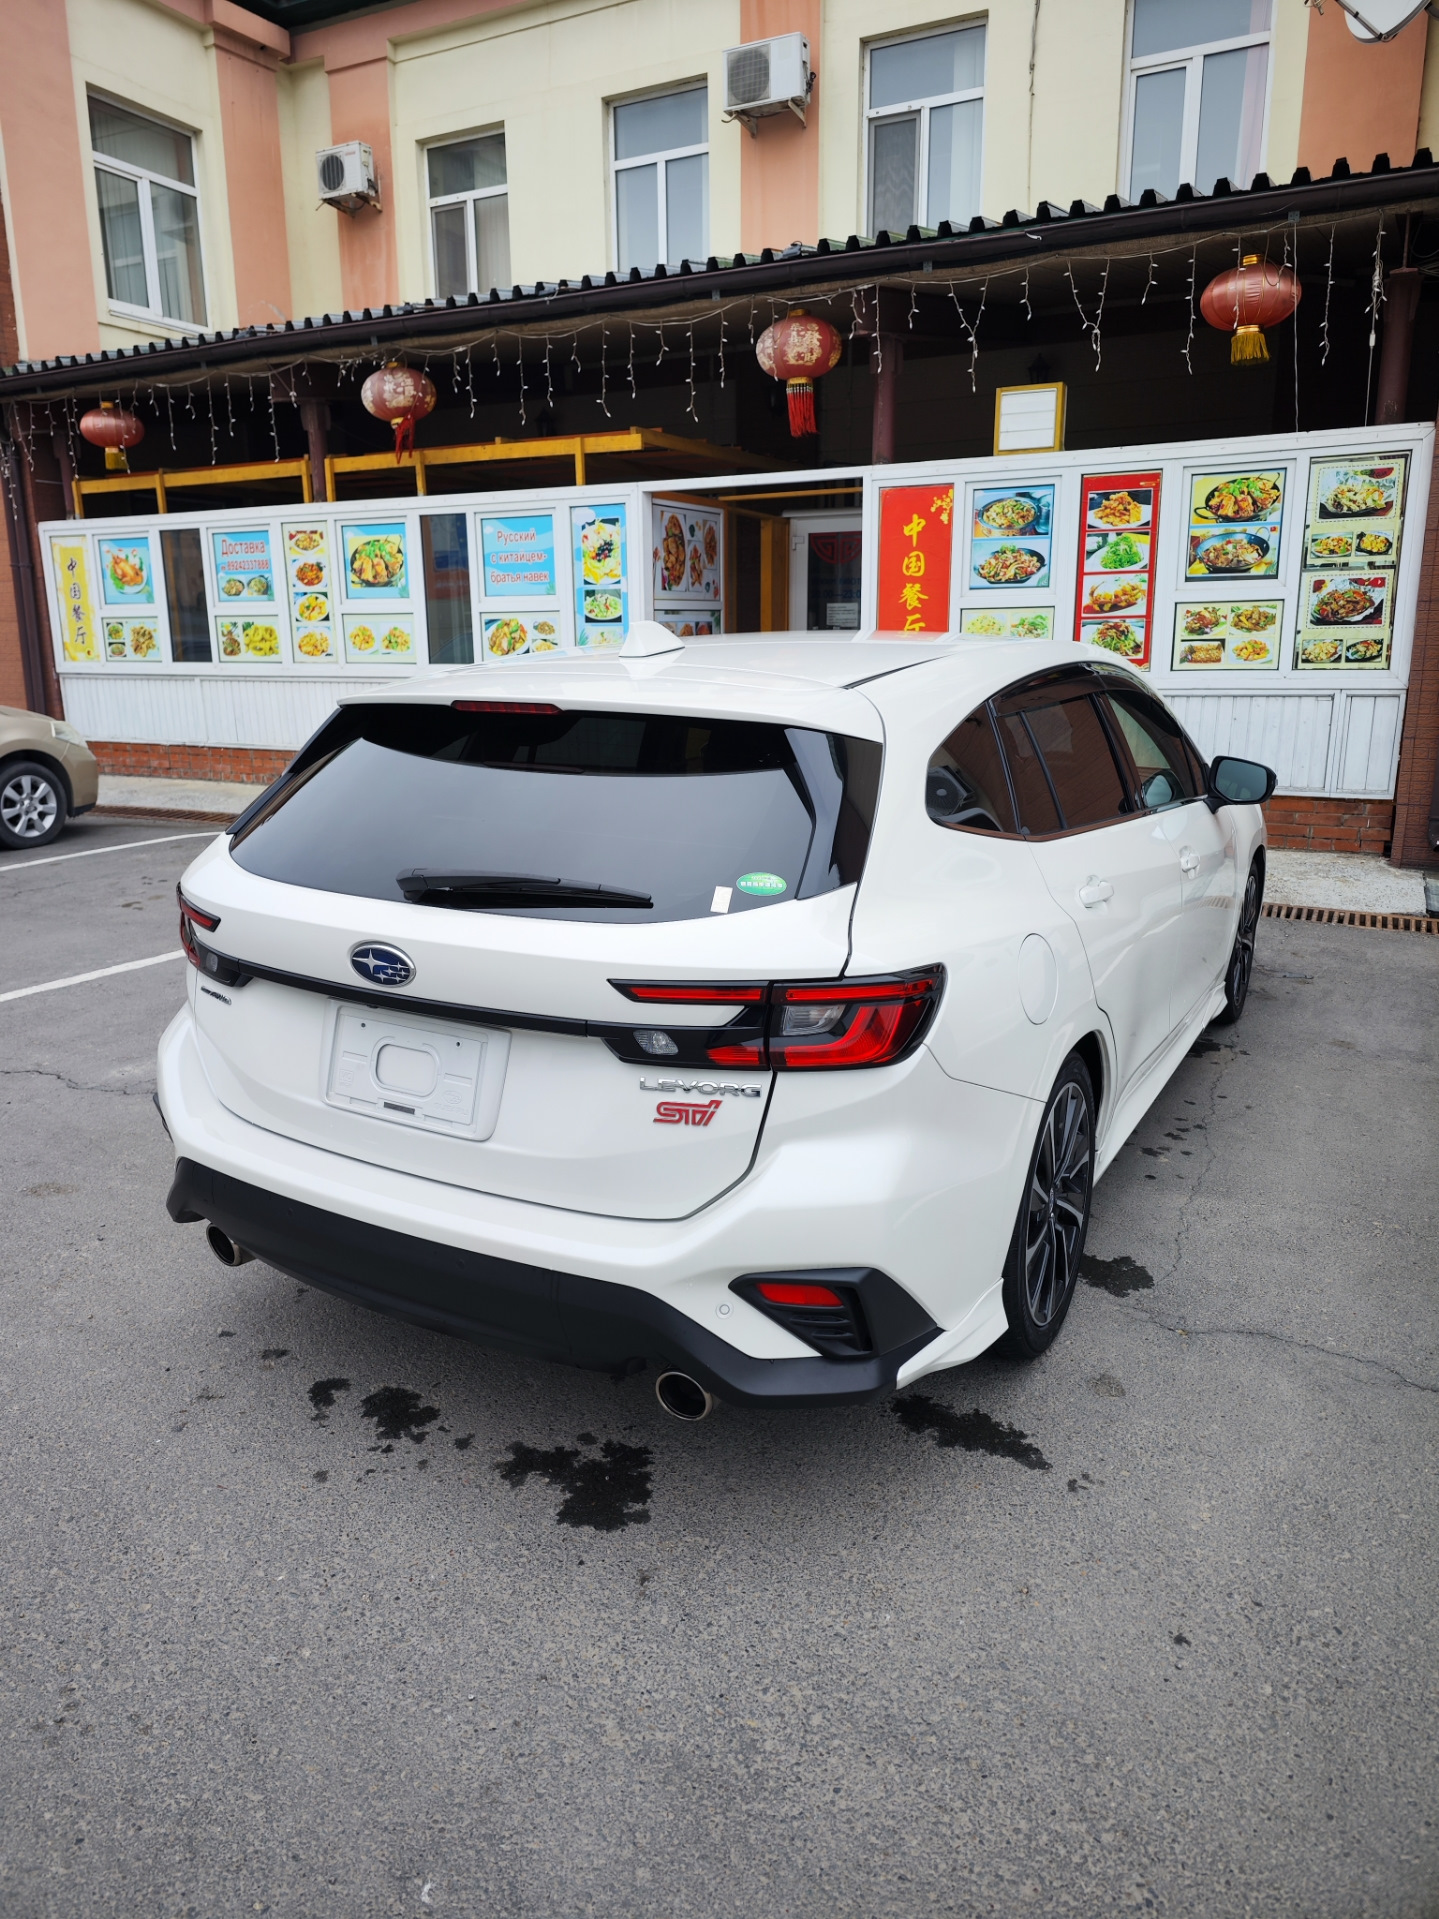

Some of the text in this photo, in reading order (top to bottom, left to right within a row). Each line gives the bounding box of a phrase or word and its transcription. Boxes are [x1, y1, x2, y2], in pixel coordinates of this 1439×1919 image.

[497, 529, 536, 546] Русский
[221, 539, 266, 557] Доставка
[490, 571, 549, 584] братья навек
[639, 1077, 761, 1098] LEVORG
